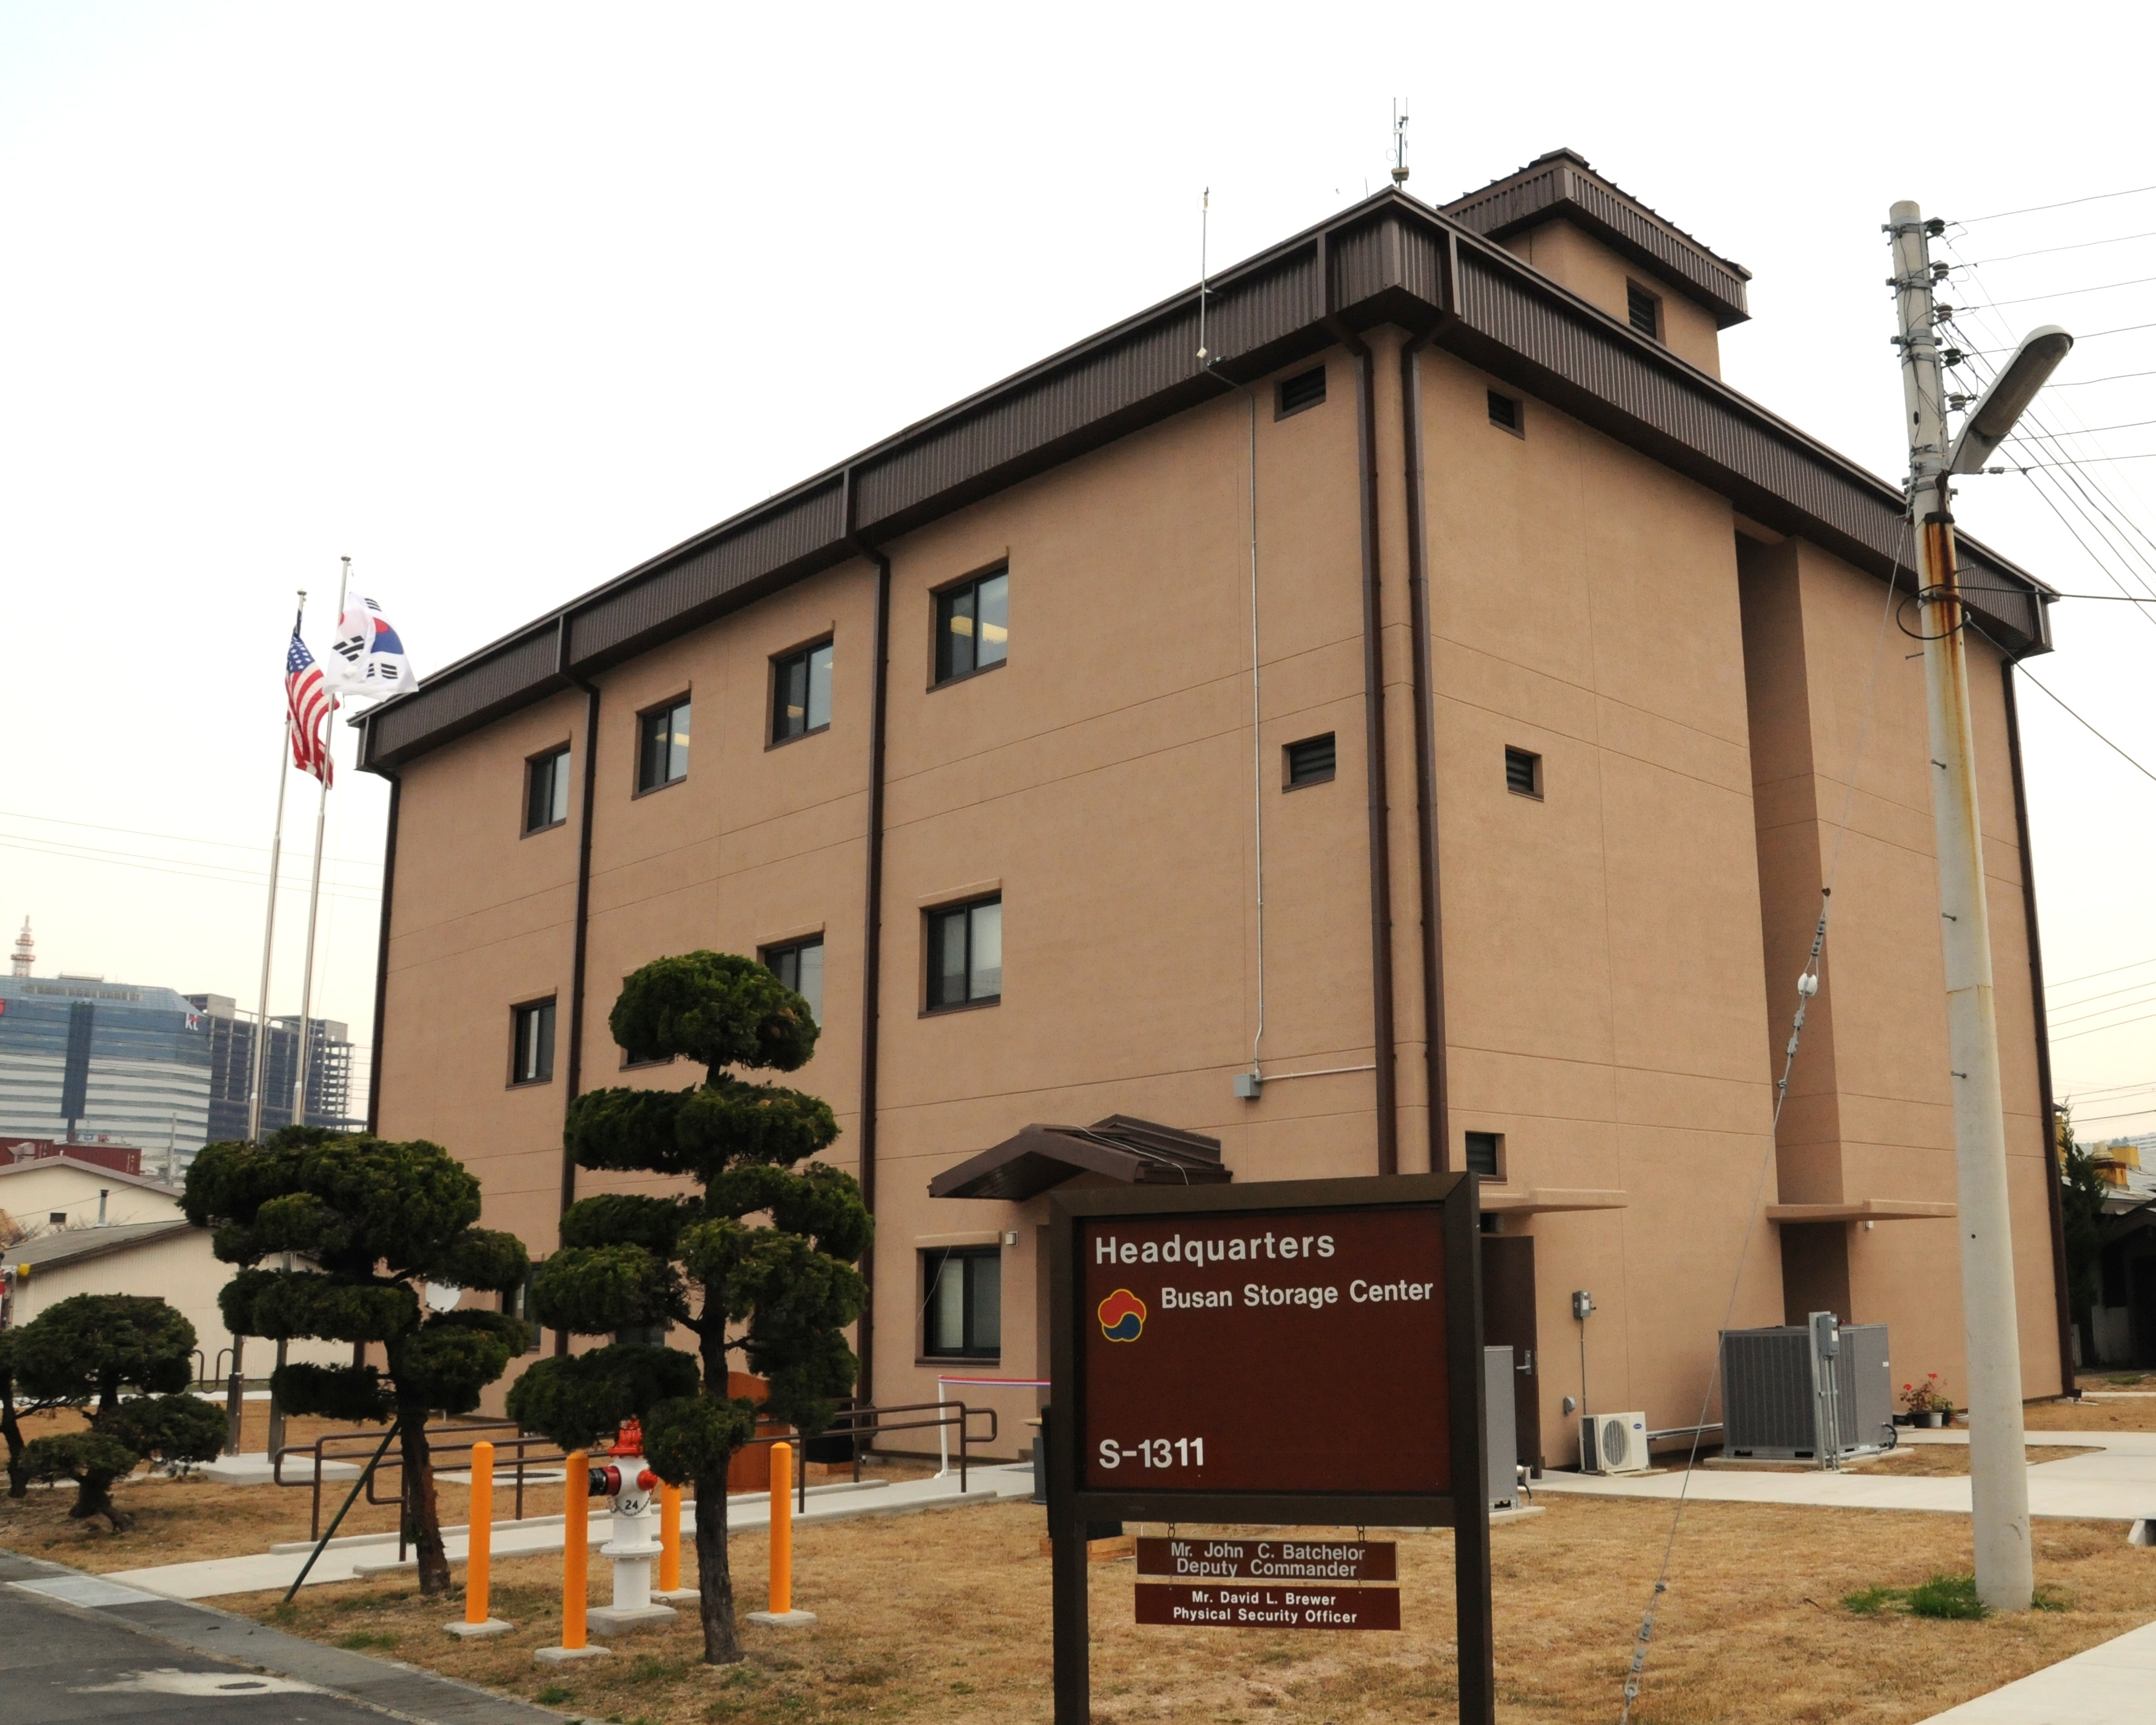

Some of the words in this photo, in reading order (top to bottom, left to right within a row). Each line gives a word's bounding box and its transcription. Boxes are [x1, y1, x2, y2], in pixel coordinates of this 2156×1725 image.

[185, 1012, 199, 1031] kt
[1095, 1232, 1336, 1267] Headquarters
[1161, 1287, 1233, 1309] Busan
[1243, 1283, 1339, 1309] Storage
[1349, 1279, 1434, 1303] Center
[1098, 1436, 1204, 1469] S-1311
[625, 1499, 639, 1510] 24
[1171, 1542, 1193, 1557] Mr.
[1203, 1542, 1244, 1558] John
[1257, 1543, 1275, 1560] C.
[1282, 1544, 1366, 1561] Batchelor
[1176, 1558, 1239, 1578] Deputy
[1249, 1558, 1357, 1577] Commander
[1191, 1590, 1213, 1603] Mr.
[1220, 1591, 1260, 1605] David
[1266, 1592, 1279, 1605] L.
[1285, 1592, 1337, 1606] Brewer
[1173, 1606, 1231, 1623] Physical
[1237, 1608, 1299, 1625] Security
[1305, 1609, 1358, 1624] Officer
